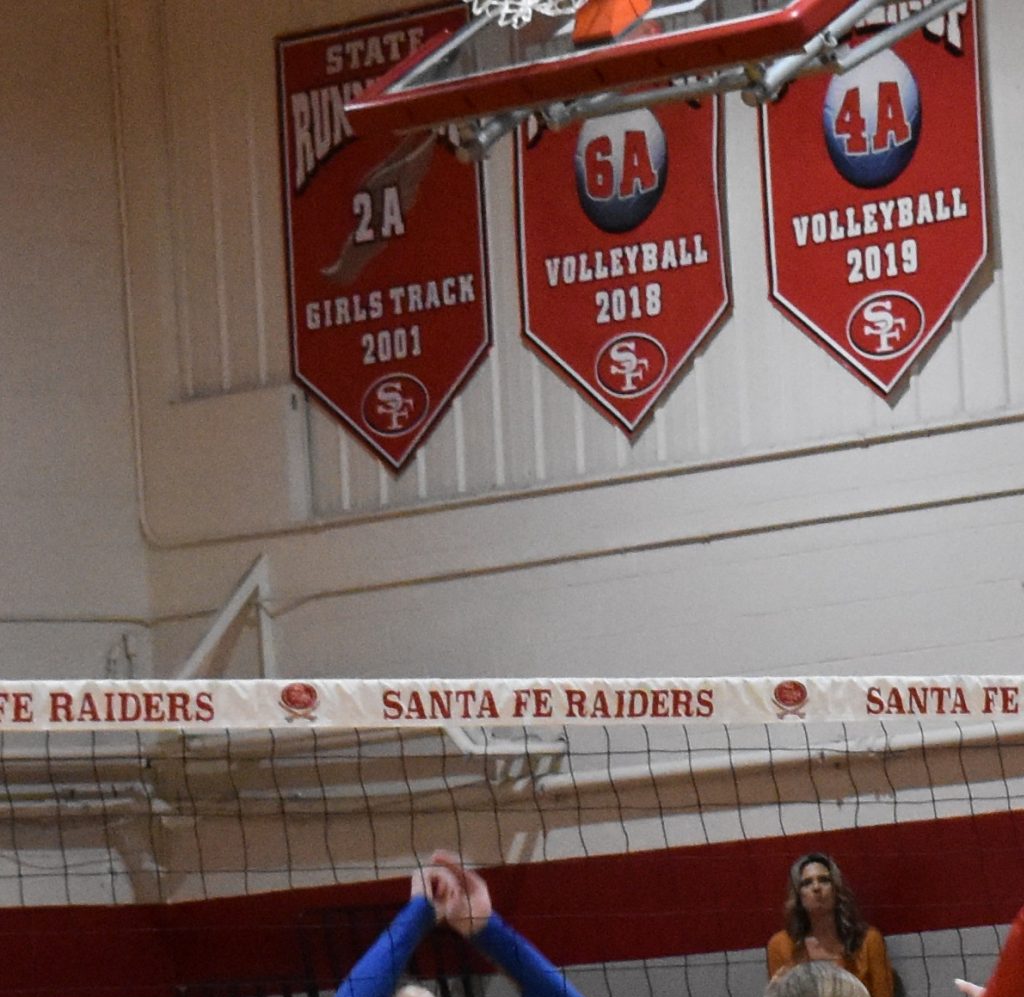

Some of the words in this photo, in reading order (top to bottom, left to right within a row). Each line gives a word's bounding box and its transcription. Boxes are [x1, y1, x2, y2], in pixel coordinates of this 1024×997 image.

[834, 81, 912, 156] 4A
[583, 130, 658, 201] 6A
[792, 187, 968, 247] VOLLEYBALL
[545, 234, 709, 287] VOLLEYBALL
[846, 239, 919, 283] 2019
[306, 291, 384, 330] GIRLS
[389, 273, 476, 315] TRACK
[596, 282, 662, 324] 2018
[361, 325, 422, 365] 2001
[48, 691, 215, 723] RAIDERS
[382, 689, 500, 720] SANTA
[512, 688, 553, 719] FE
[565, 688, 714, 719] RAIDERS
[866, 685, 970, 715] SANTA
[981, 685, 1019, 714] FE
